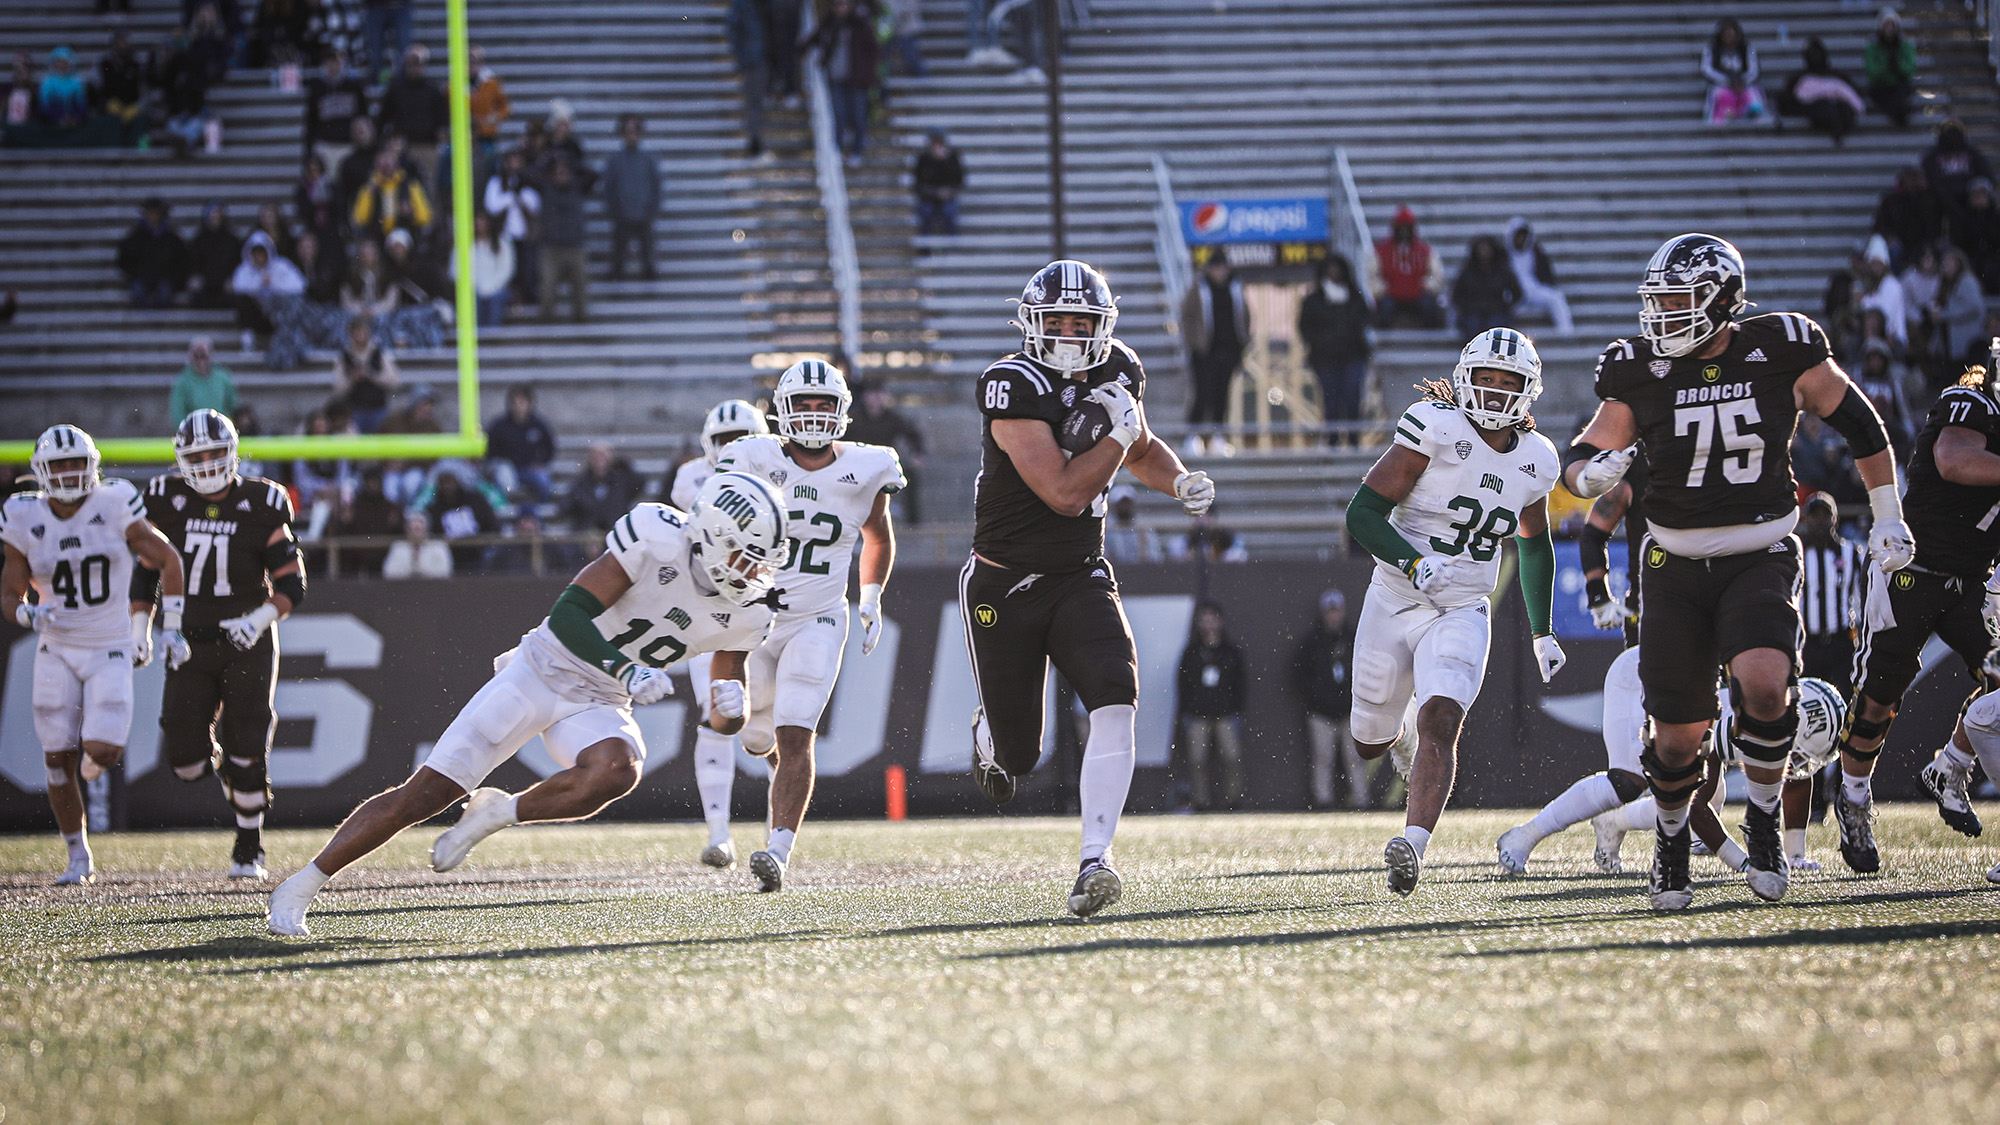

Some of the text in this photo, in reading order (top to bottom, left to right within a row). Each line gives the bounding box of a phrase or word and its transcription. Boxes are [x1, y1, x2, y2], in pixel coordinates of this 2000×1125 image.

[1706, 368, 1717, 379] W
[985, 379, 1011, 410] 86
[1675, 382, 1752, 406] BRONCOS
[1949, 401, 1972, 423] 77
[1674, 397, 1766, 487] 75
[794, 485, 818, 501] OHIO
[1479, 473, 1504, 494] OHIO
[713, 489, 756, 532] OHIO
[185, 518, 238, 535] BRONCOS
[1429, 495, 1519, 562] 38
[60, 537, 81, 551] OHIO
[184, 532, 232, 597] 71
[1651, 550, 1663, 564] W
[52, 555, 110, 610] 40
[1900, 575, 1911, 587] W
[663, 607, 692, 631] OHIO
[817, 616, 836, 627] OHIO
[978, 610, 992, 624] W
